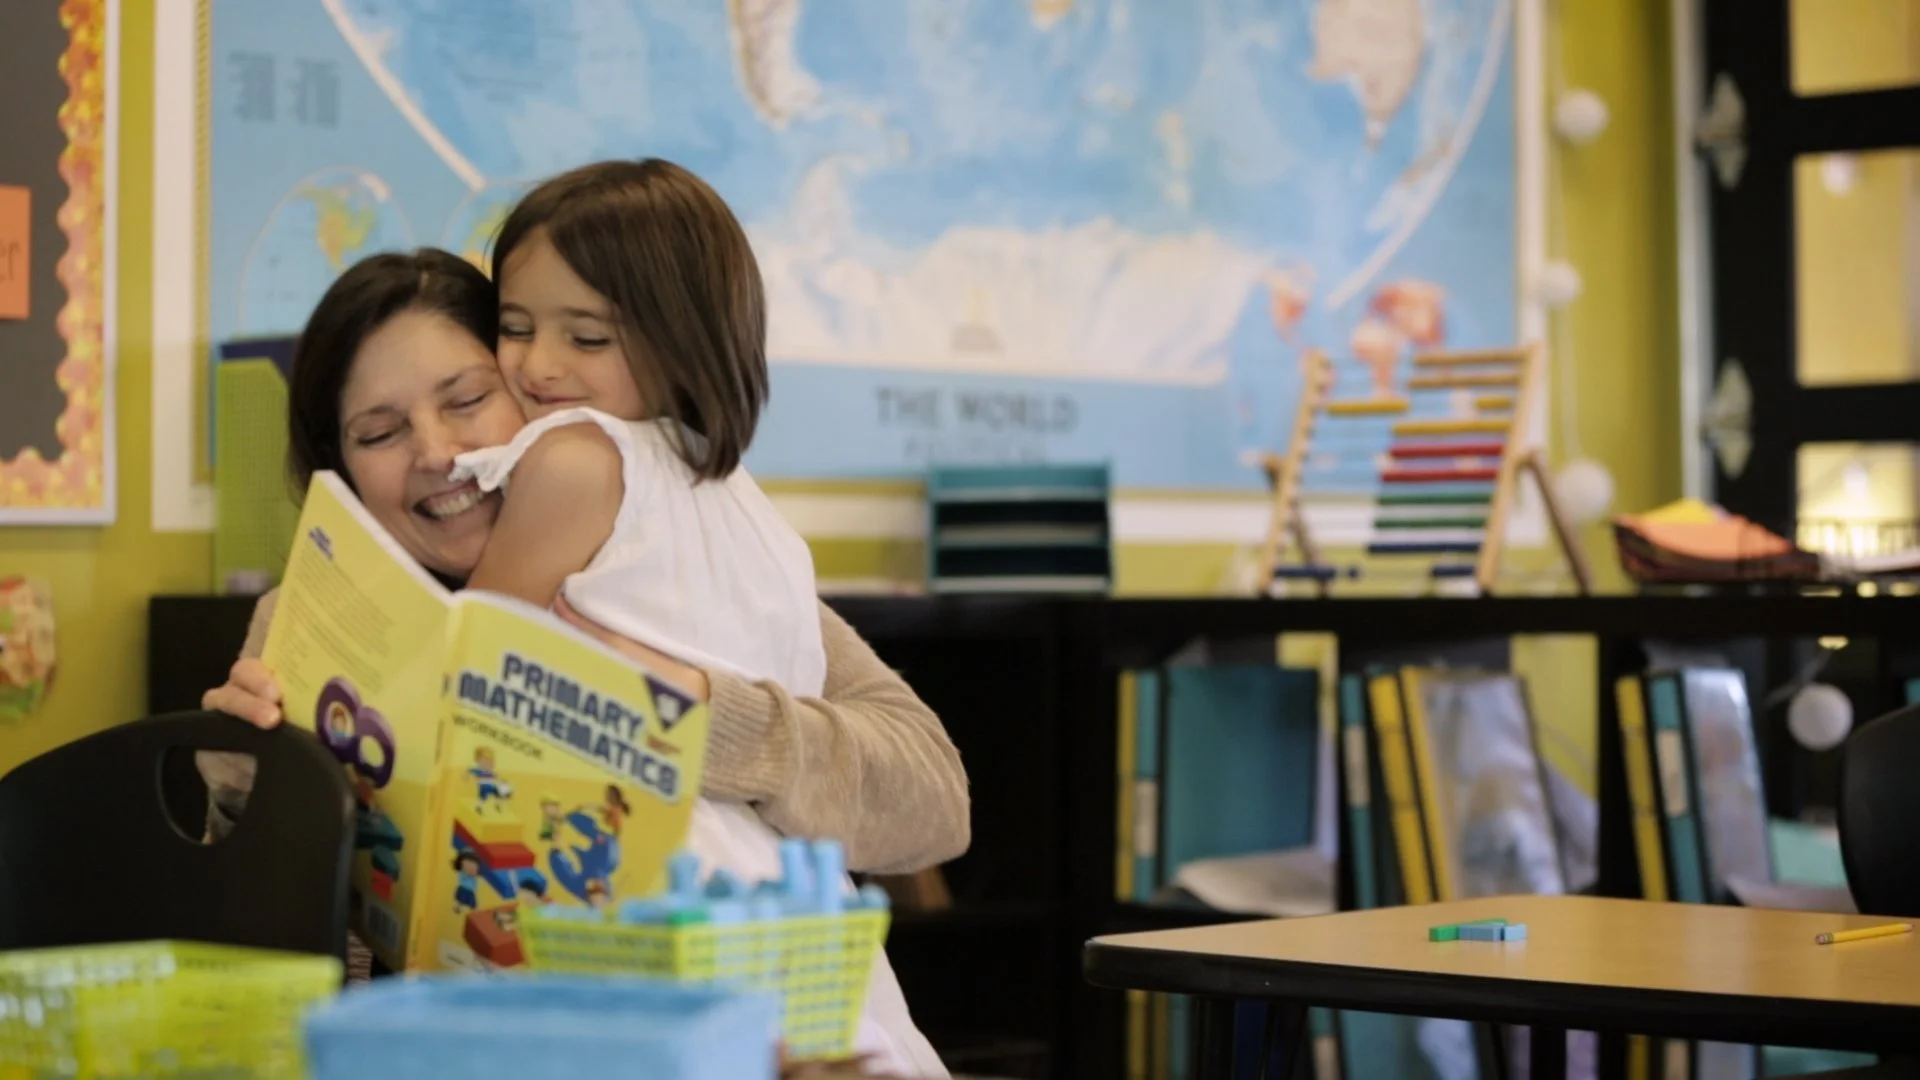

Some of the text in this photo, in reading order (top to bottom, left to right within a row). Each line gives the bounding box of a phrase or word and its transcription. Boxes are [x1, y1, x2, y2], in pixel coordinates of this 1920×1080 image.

[875, 385, 1080, 434] THE WORLD
[503, 653, 644, 739] PRIMARY
[453, 712, 543, 760] WORKBOOK
[459, 672, 679, 797] MATHEMATICS
